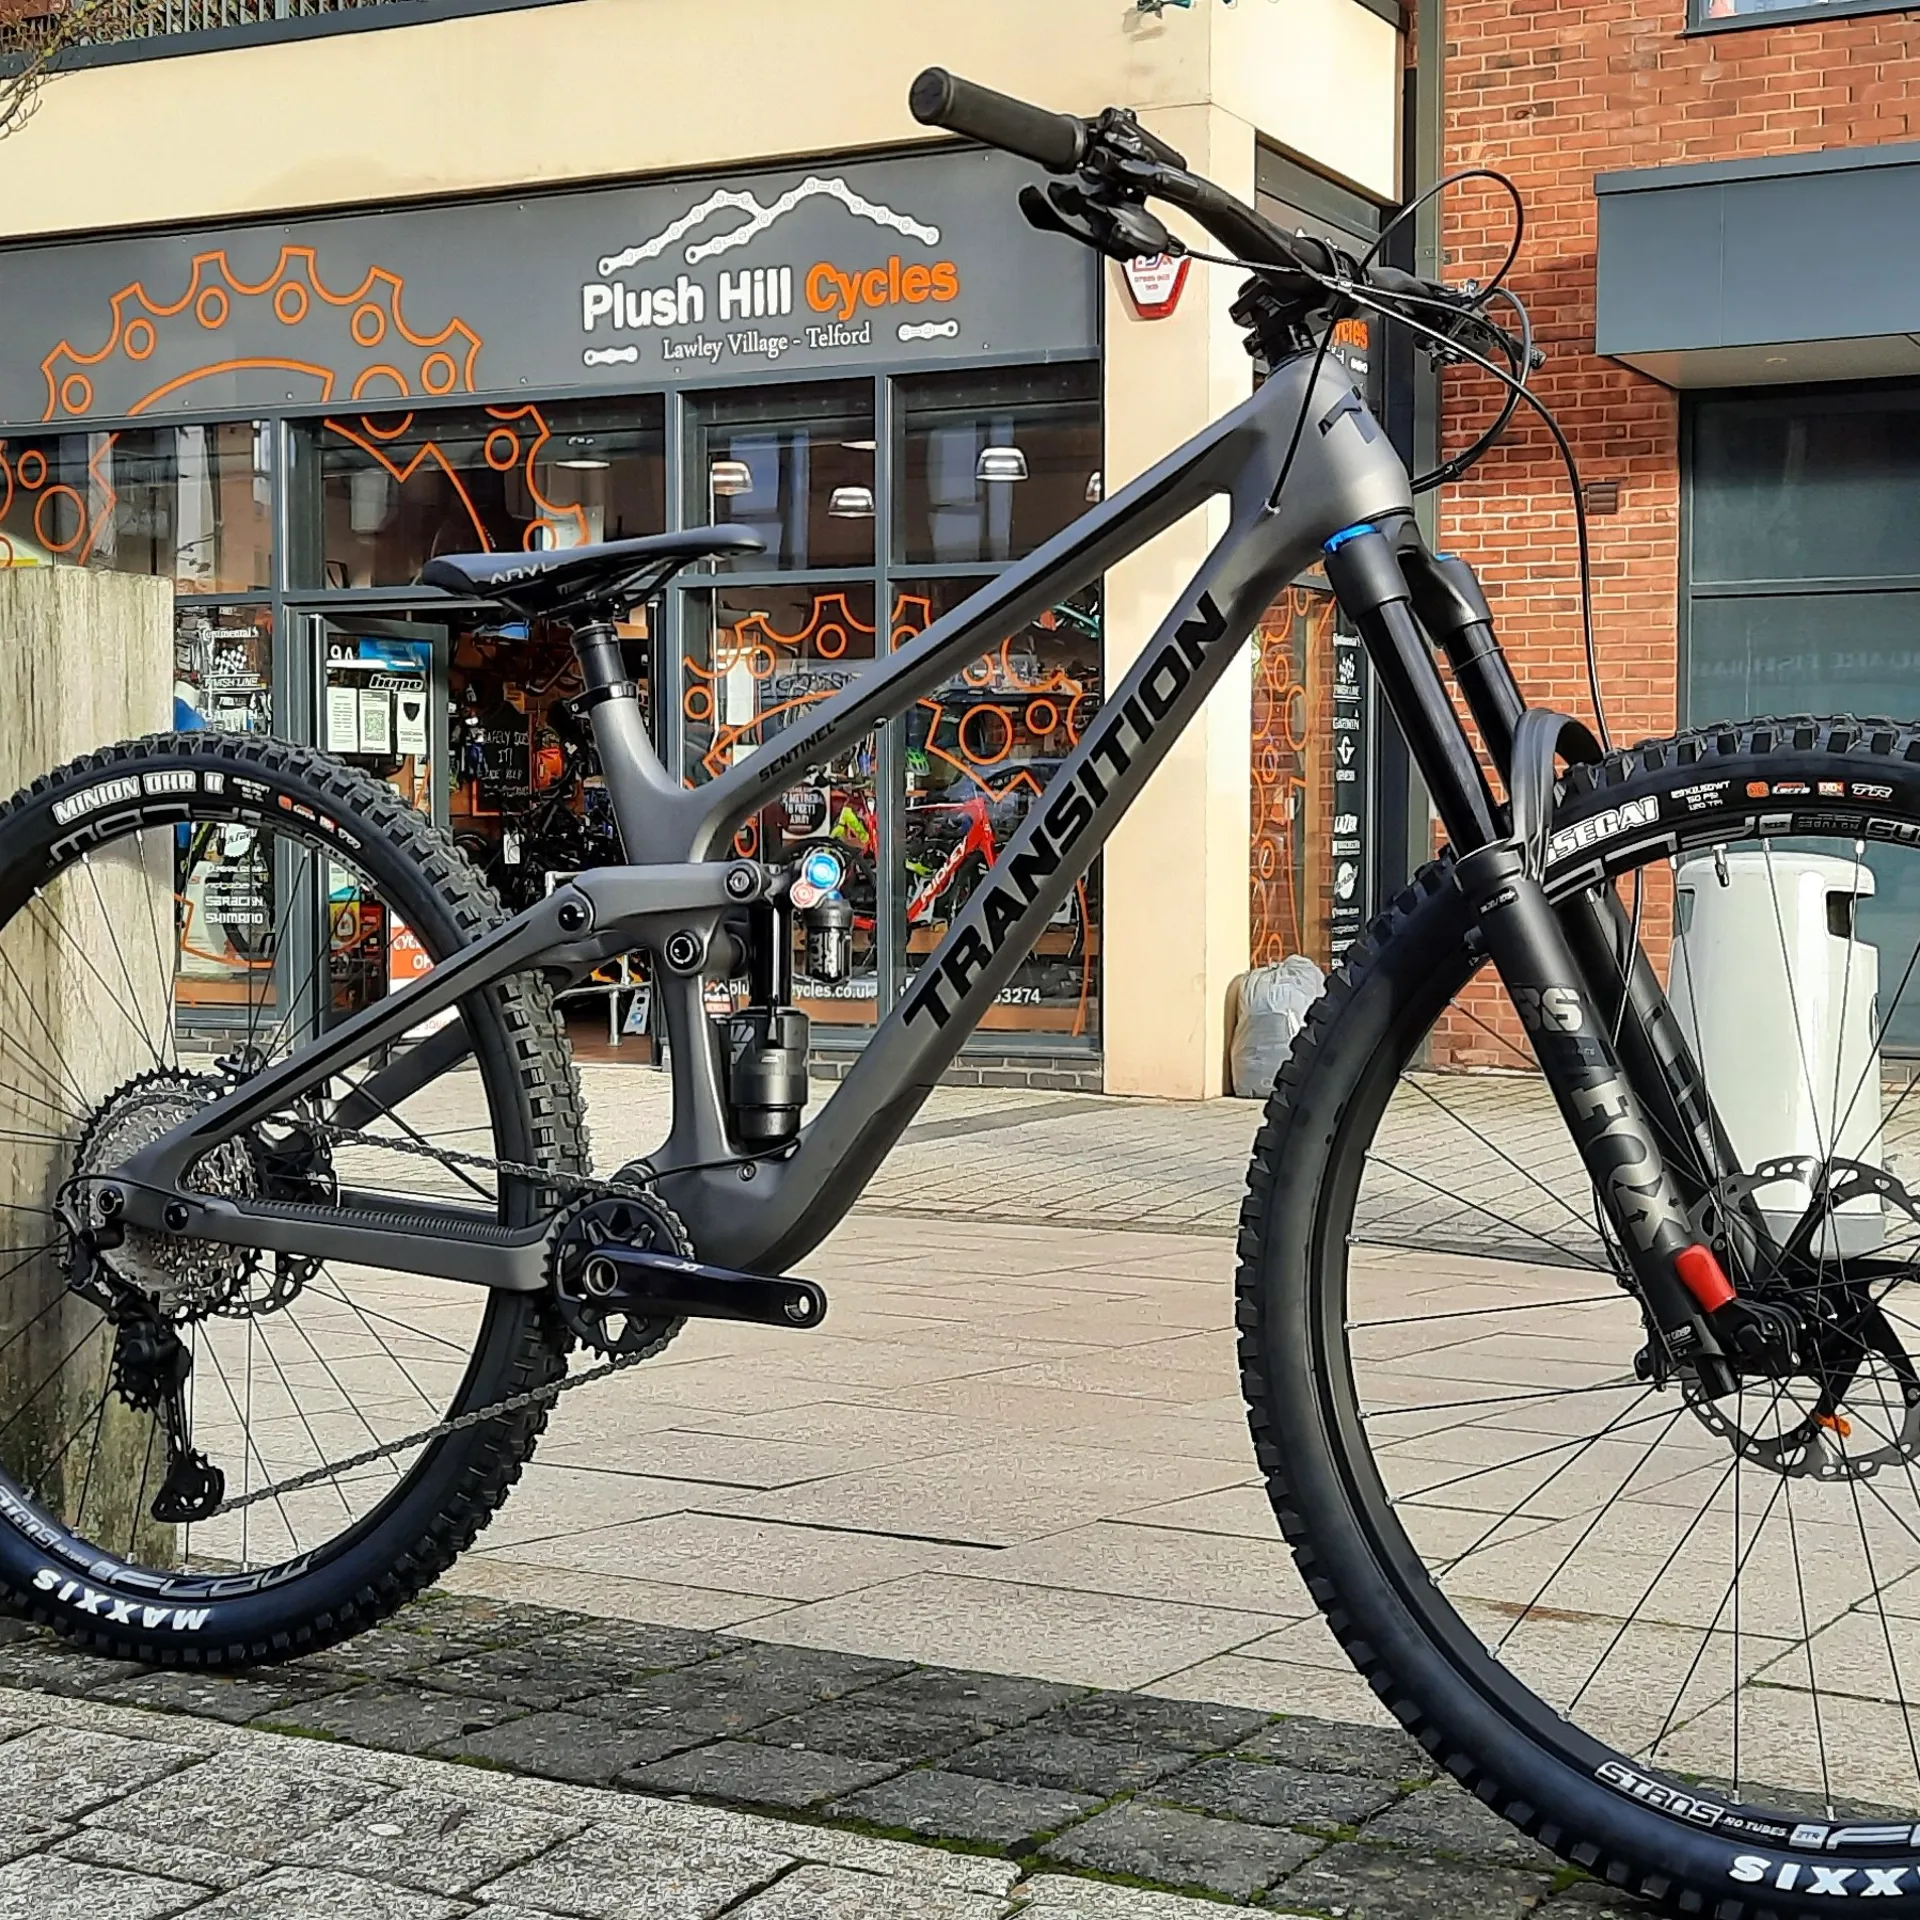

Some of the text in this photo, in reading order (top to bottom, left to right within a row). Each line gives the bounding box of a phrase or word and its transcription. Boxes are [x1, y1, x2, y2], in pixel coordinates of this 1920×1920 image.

[582, 255, 959, 331] Plush Hill Cycles
[663, 334, 724, 363] Lawley
[727, 328, 789, 360] Village
[805, 321, 872, 349] Telford
[369, 673, 423, 694] hope
[759, 723, 836, 783] SENTINEL
[52, 775, 141, 825] MINION
[143, 770, 197, 795] DHR
[204, 771, 225, 795] II
[902, 590, 1228, 1029] TRANSITION
[921, 836, 967, 904] RIDLEY
[205, 912, 263, 924] SHIMANO
[1571, 1069, 1692, 1253] FOX
[33, 1568, 211, 1631] MAXXIS
[1723, 1815, 1744, 1829] NO
[1745, 1820, 1789, 1837] TUBES
